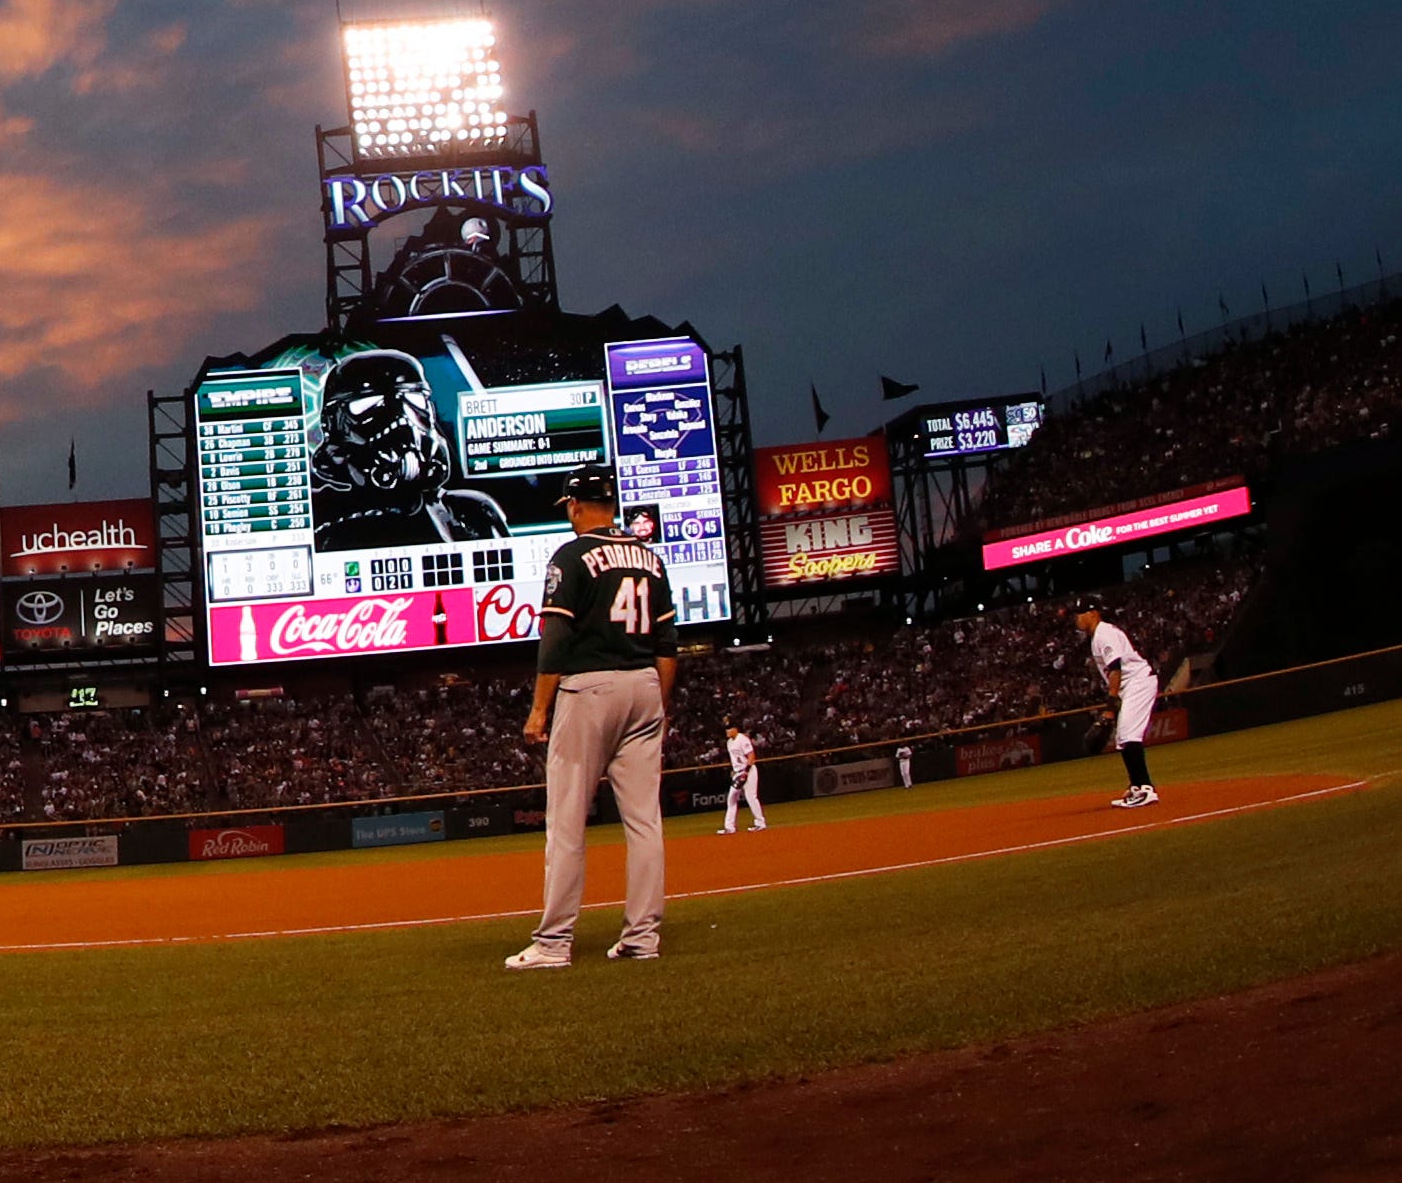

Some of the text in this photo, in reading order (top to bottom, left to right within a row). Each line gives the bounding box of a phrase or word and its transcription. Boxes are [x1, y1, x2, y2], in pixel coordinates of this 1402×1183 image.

[323, 164, 553, 229] ROCKIES
[208, 387, 293, 408] EMPIRE
[466, 400, 497, 414] BRETT
[467, 413, 546, 439] ANDERSON
[926, 417, 952, 432] TOTAL
[955, 410, 994, 431] $6,445
[468, 442, 491, 455] GAME
[493, 439, 536, 453] SUMMARY:
[930, 430, 996, 451] PRIZE $3,220
[499, 456, 536, 468] GROUNDED
[773, 445, 870, 476] WELLS
[778, 475, 872, 506] FARGO
[22, 519, 136, 552] uchealth
[667, 525, 679, 537] 31
[705, 521, 716, 534] 45
[785, 516, 874, 554] KING
[1012, 540, 1052, 559] SHARE
[1054, 538, 1065, 550] A
[1066, 525, 1115, 550] Coke
[1117, 522, 1133, 535] FOR
[1134, 520, 1149, 531] THE
[1149, 515, 1169, 528] BEST
[1202, 504, 1218, 516] YET
[582, 544, 662, 579] PEDRIQUE
[786, 551, 876, 581] Soopers
[95, 587, 134, 602] Let's
[94, 605, 118, 619] Go
[610, 577, 650, 634] 41
[13, 627, 72, 640] TOYOTA
[96, 620, 153, 637] Places
[270, 597, 414, 654] Coca-Cola
[1344, 685, 1364, 696] 415
[468, 817, 490, 827] 390
[356, 829, 375, 840] The
[202, 836, 269, 857] Red Robin
